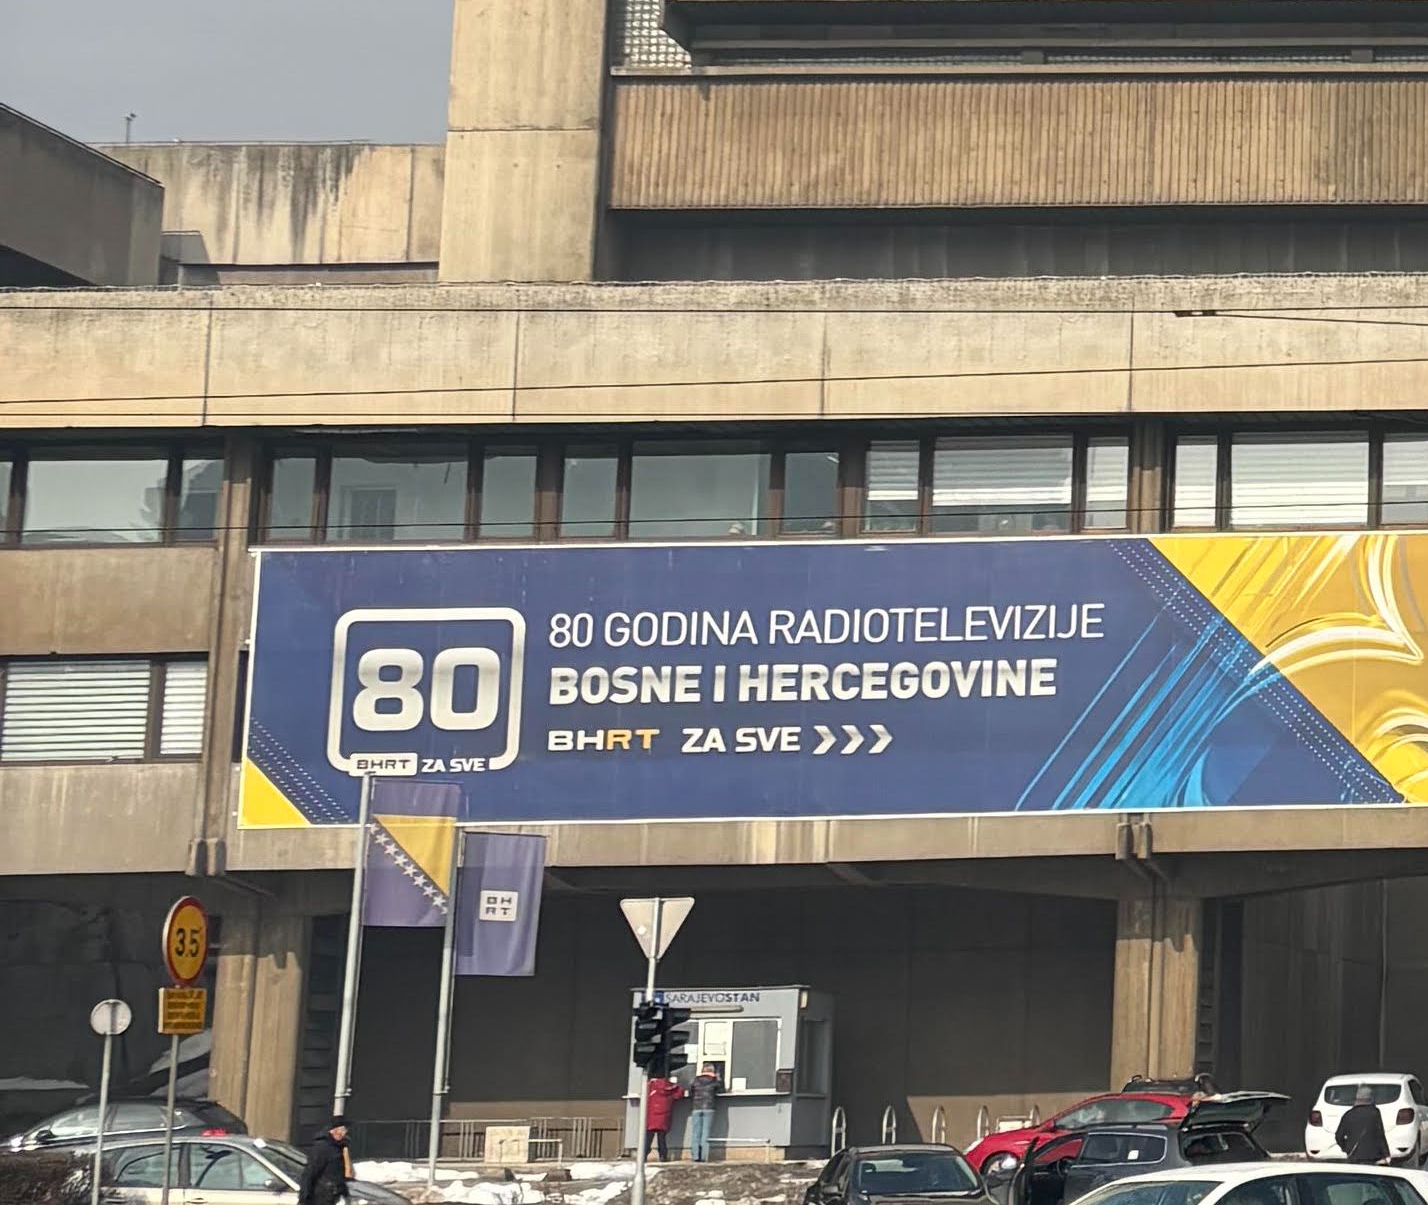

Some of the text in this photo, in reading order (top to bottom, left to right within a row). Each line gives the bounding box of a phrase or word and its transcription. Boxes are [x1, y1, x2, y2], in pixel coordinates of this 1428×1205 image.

[549, 603, 1104, 648] 80 GODINA RADIOTELEVIZIJE
[353, 647, 501, 731] 80
[549, 658, 1057, 705] BOSNE I HERCEGOVINE
[547, 726, 801, 753] BHRT ZA SVE
[356, 757, 485, 773] BHRT ZA SVE
